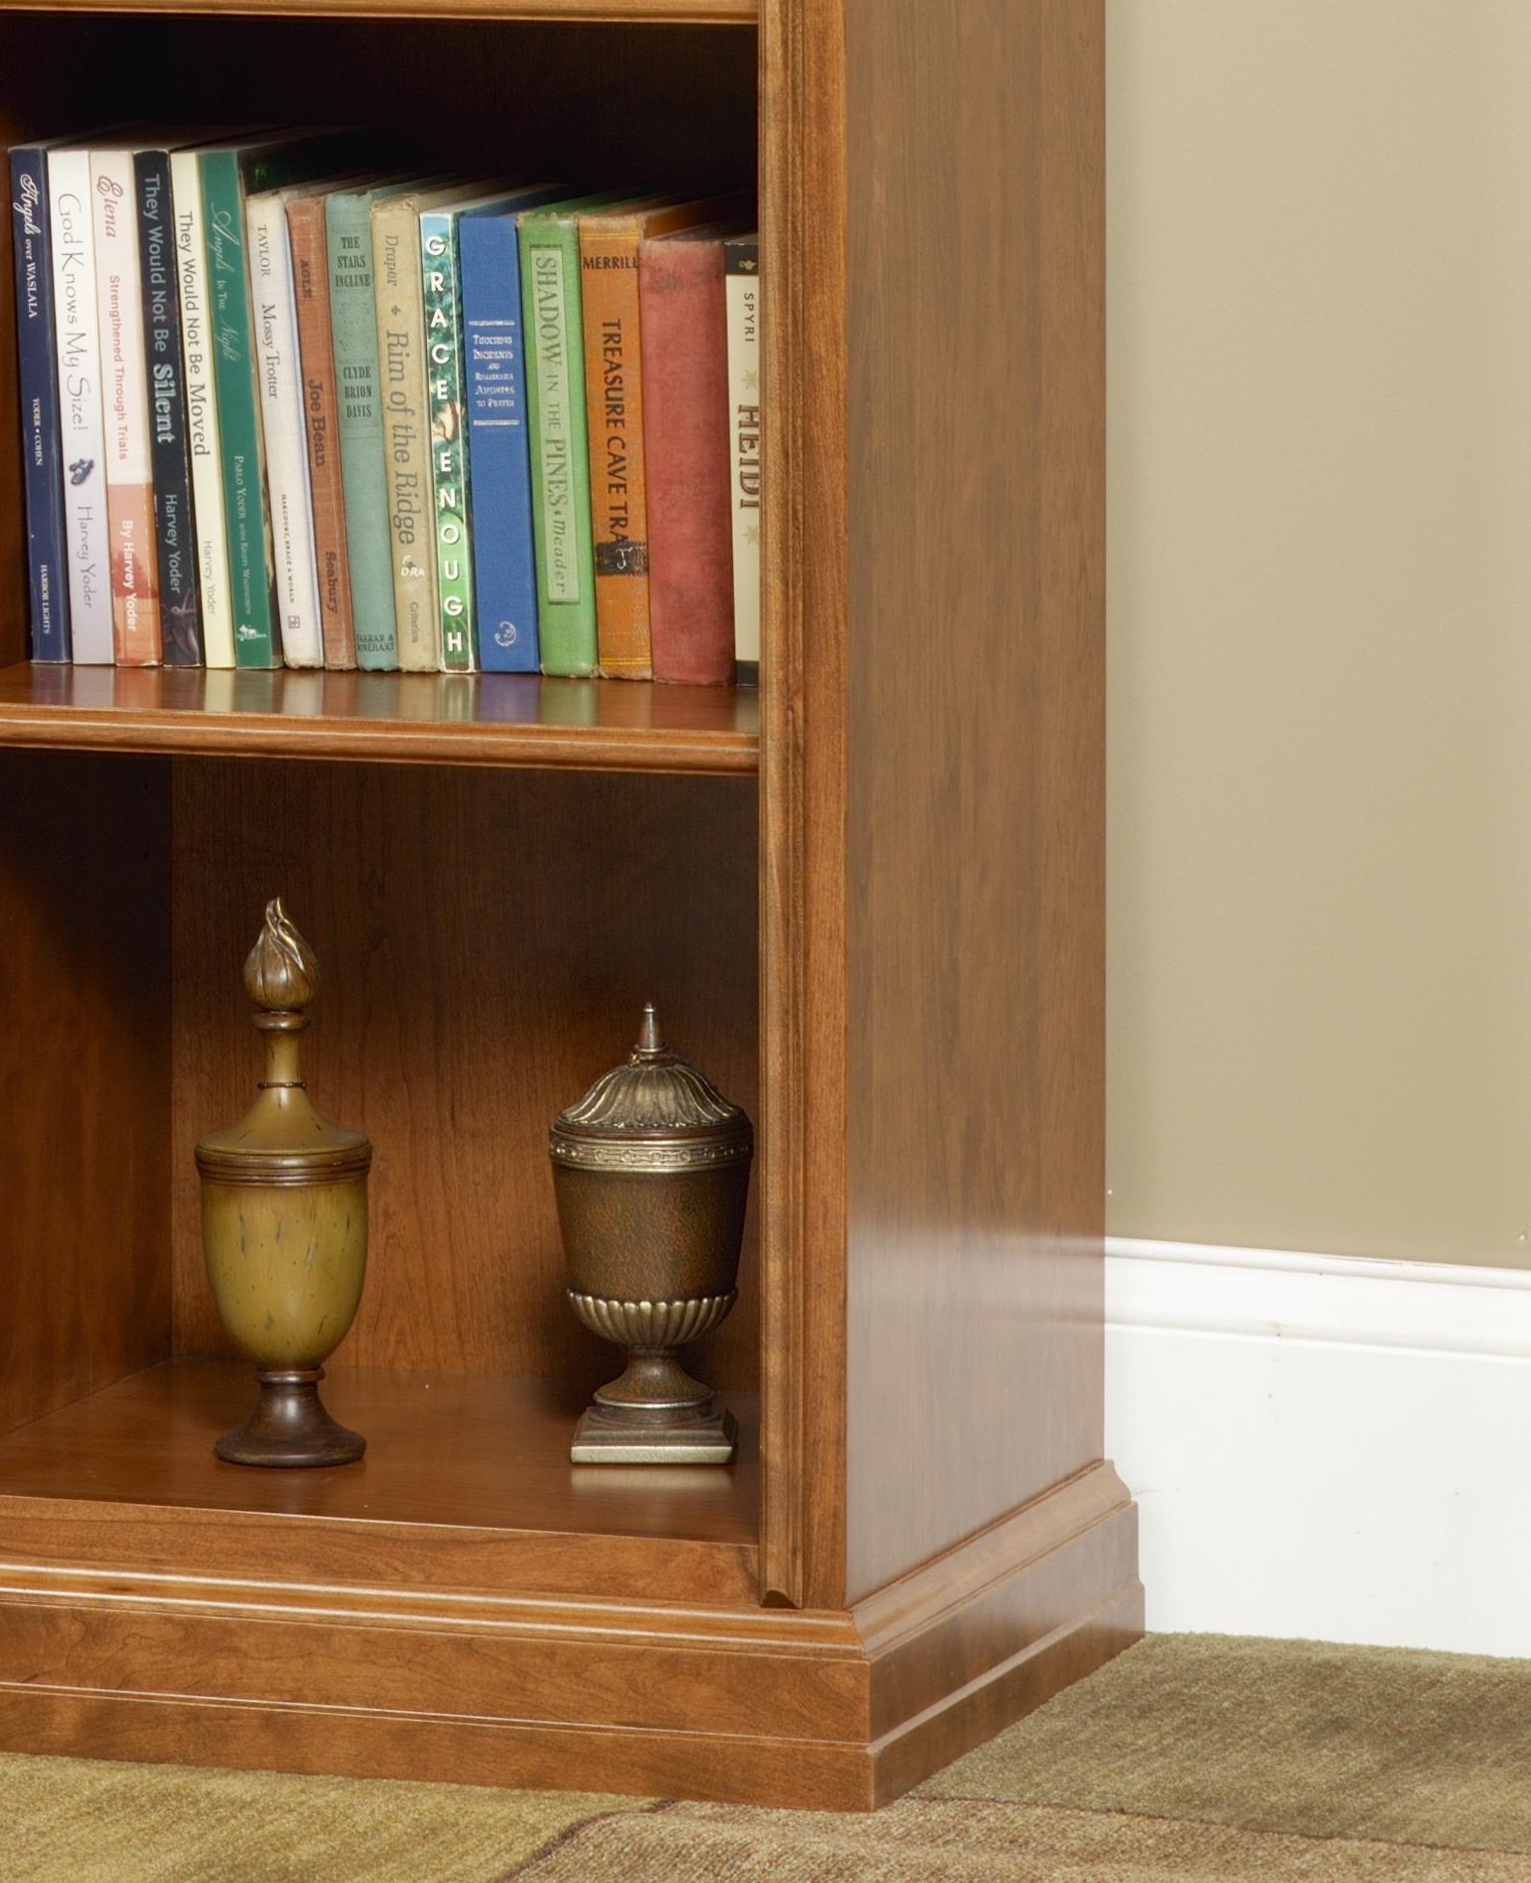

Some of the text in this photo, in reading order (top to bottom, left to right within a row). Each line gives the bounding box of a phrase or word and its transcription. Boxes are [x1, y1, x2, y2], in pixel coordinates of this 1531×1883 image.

[13, 174, 42, 236] Angels
[97, 175, 124, 238] Elena
[207, 202, 241, 272] Angels
[337, 255, 367, 268] STARS
[341, 236, 361, 249] THE
[583, 255, 639, 270] MERRILL
[25, 262, 38, 318] WASLALA
[58, 193, 92, 431] God Knows My Size!
[143, 174, 176, 444] They Would Not Be Silent
[257, 224, 281, 399] TAYLOR Mossy Trotter
[300, 260, 312, 299] AGLE
[335, 274, 371, 288] INCLINE
[179, 211, 211, 457] They Would Not Be Moved
[743, 292, 756, 343] SPYRI
[109, 275, 129, 460] Strengthened Through Trials
[343, 366, 372, 379] CLYDE
[473, 349, 514, 360] INCIDENTS
[536, 257, 569, 507] SHADOW IN THE PINES
[308, 379, 326, 468] Joe Bean
[344, 386, 372, 399] BRION
[346, 406, 372, 418] DAVIS
[384, 234, 422, 545] Draper Rim of the Ridge
[602, 319, 628, 495] TREASURE CAVE
[32, 398, 44, 466] YODER COHEN
[426, 236, 464, 652] GRACE ENOUGH
[738, 404, 760, 509] HEIDI
[77, 506, 98, 608] Harvey Yoder
[121, 520, 139, 632] By Harvey Yoder
[165, 494, 183, 594] Harvey Yoder
[203, 540, 217, 616] Harvey Yoder
[400, 568, 426, 578] DRA
[40, 564, 52, 635] HARBOR LIGHTS
[325, 551, 339, 614] Seabury
[409, 601, 421, 643] Criterion
